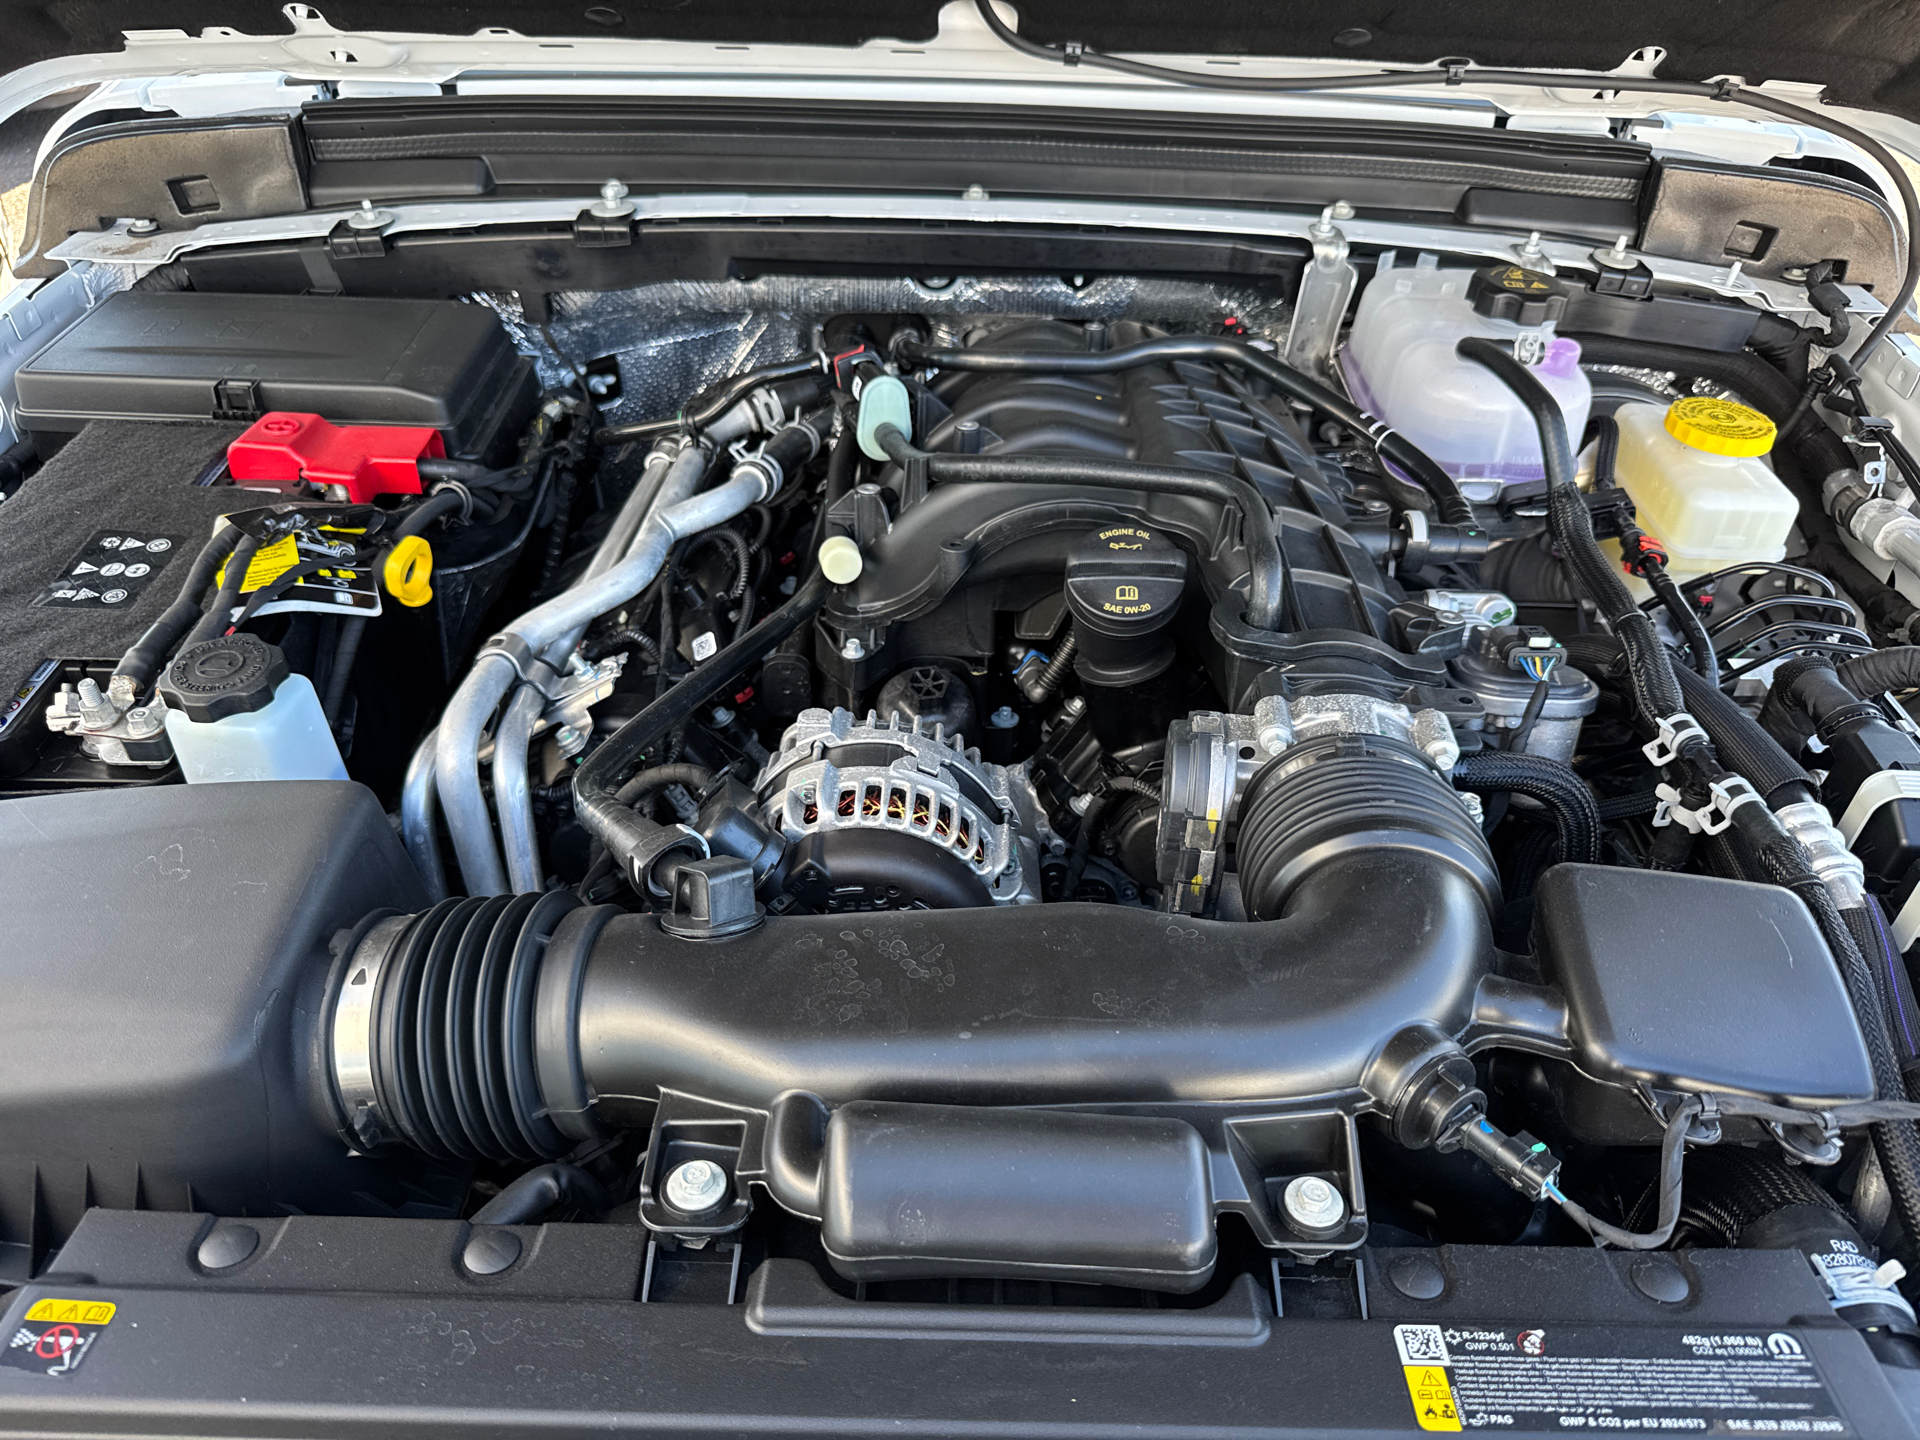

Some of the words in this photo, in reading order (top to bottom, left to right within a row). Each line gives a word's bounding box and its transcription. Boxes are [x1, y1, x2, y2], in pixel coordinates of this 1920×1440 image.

[1099, 528, 1134, 540] ENGINE
[1136, 530, 1151, 540] OIL
[1103, 602, 1122, 614] SAE
[1124, 603, 1152, 614] 0W-20
[218, 637, 264, 655] APPROVED
[1829, 1239, 1859, 1254] RAD
[1465, 1341, 1488, 1351] GWP
[1490, 1342, 1515, 1351] 0.501
[1682, 1334, 1711, 1347] 482g
[1744, 1336, 1763, 1348] lb)
[1692, 1346, 1714, 1356] CO2
[1714, 1347, 1728, 1357] eq
[1489, 1414, 1515, 1425] PAG
[1559, 1416, 1586, 1427] GWP
[1587, 1416, 1597, 1428] &
[1597, 1417, 1622, 1428] CO2
[1623, 1419, 1641, 1430] per
[1641, 1417, 1659, 1429] EU
[1660, 1417, 1706, 1430] 2024/573
[1726, 1420, 1752, 1431] SAE
